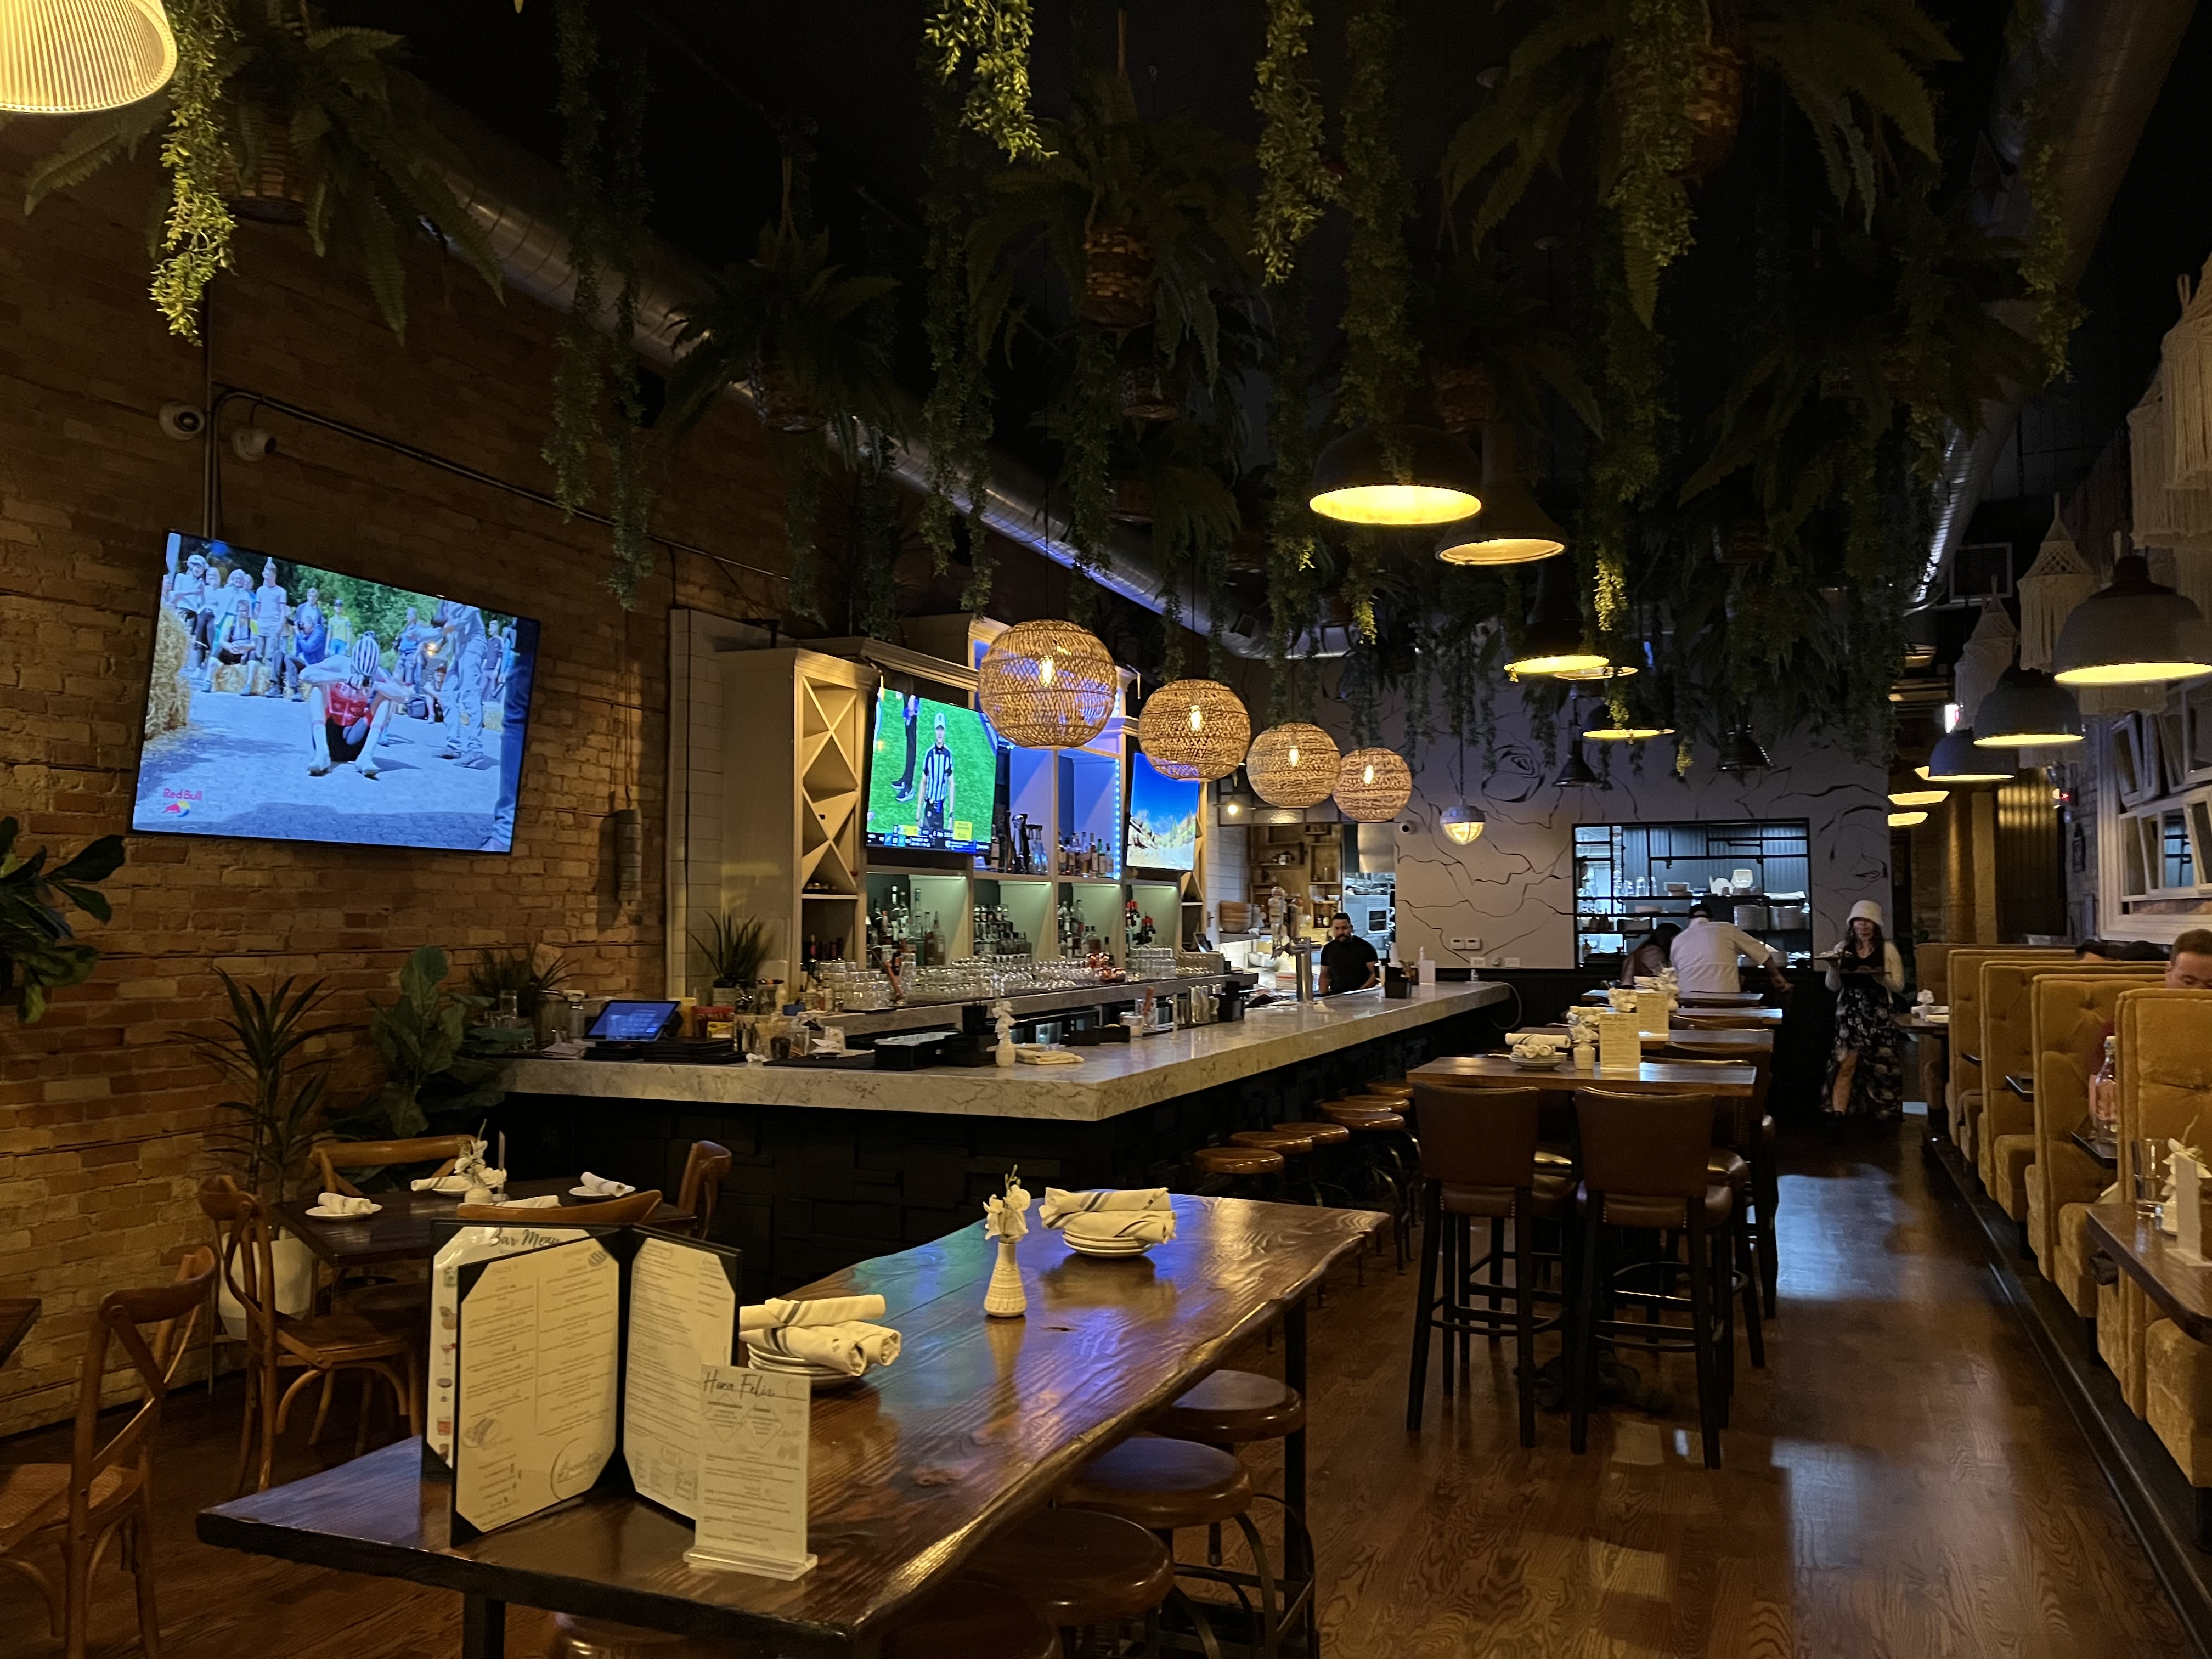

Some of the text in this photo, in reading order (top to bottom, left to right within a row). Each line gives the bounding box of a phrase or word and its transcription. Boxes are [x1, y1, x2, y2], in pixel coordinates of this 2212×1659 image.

[163, 788, 202, 800] Red Bull
[488, 1227, 518, 1248] Bar
